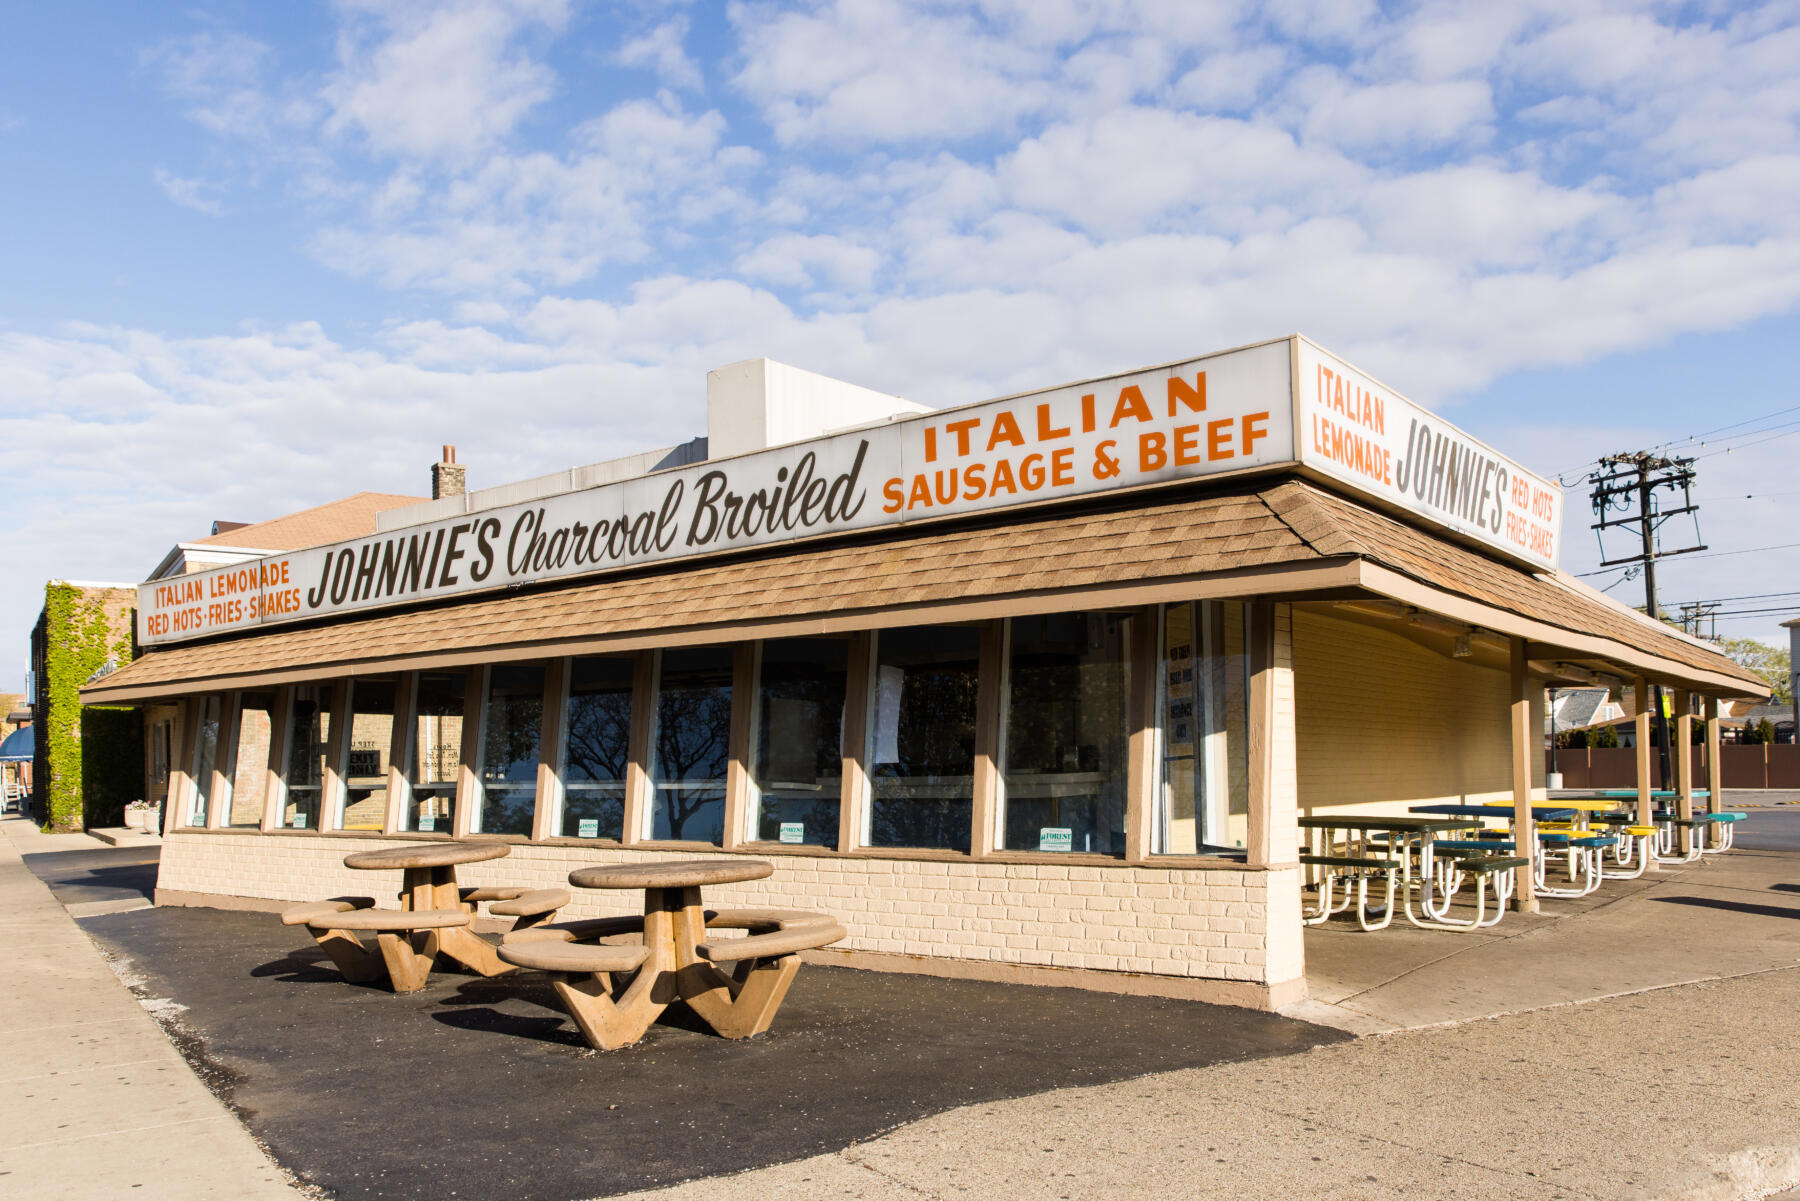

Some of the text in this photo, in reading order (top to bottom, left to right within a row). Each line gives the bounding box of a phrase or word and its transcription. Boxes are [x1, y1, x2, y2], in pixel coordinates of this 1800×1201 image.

[924, 371, 1207, 463] ITALIAN
[1317, 363, 1385, 436] ITALIAN
[882, 411, 1270, 514] SAUSAGE & BEEF
[1313, 413, 1391, 486] LEMONADE
[1396, 417, 1507, 535] JOHNNIE'S
[308, 439, 869, 608] JOHNNIE'S Charcoal Broiled
[1511, 474, 1553, 523] RED HOTS
[148, 588, 300, 636] RED HOTS FRIES SHAKES
[156, 560, 289, 609] ITALIAN LEMONADE
